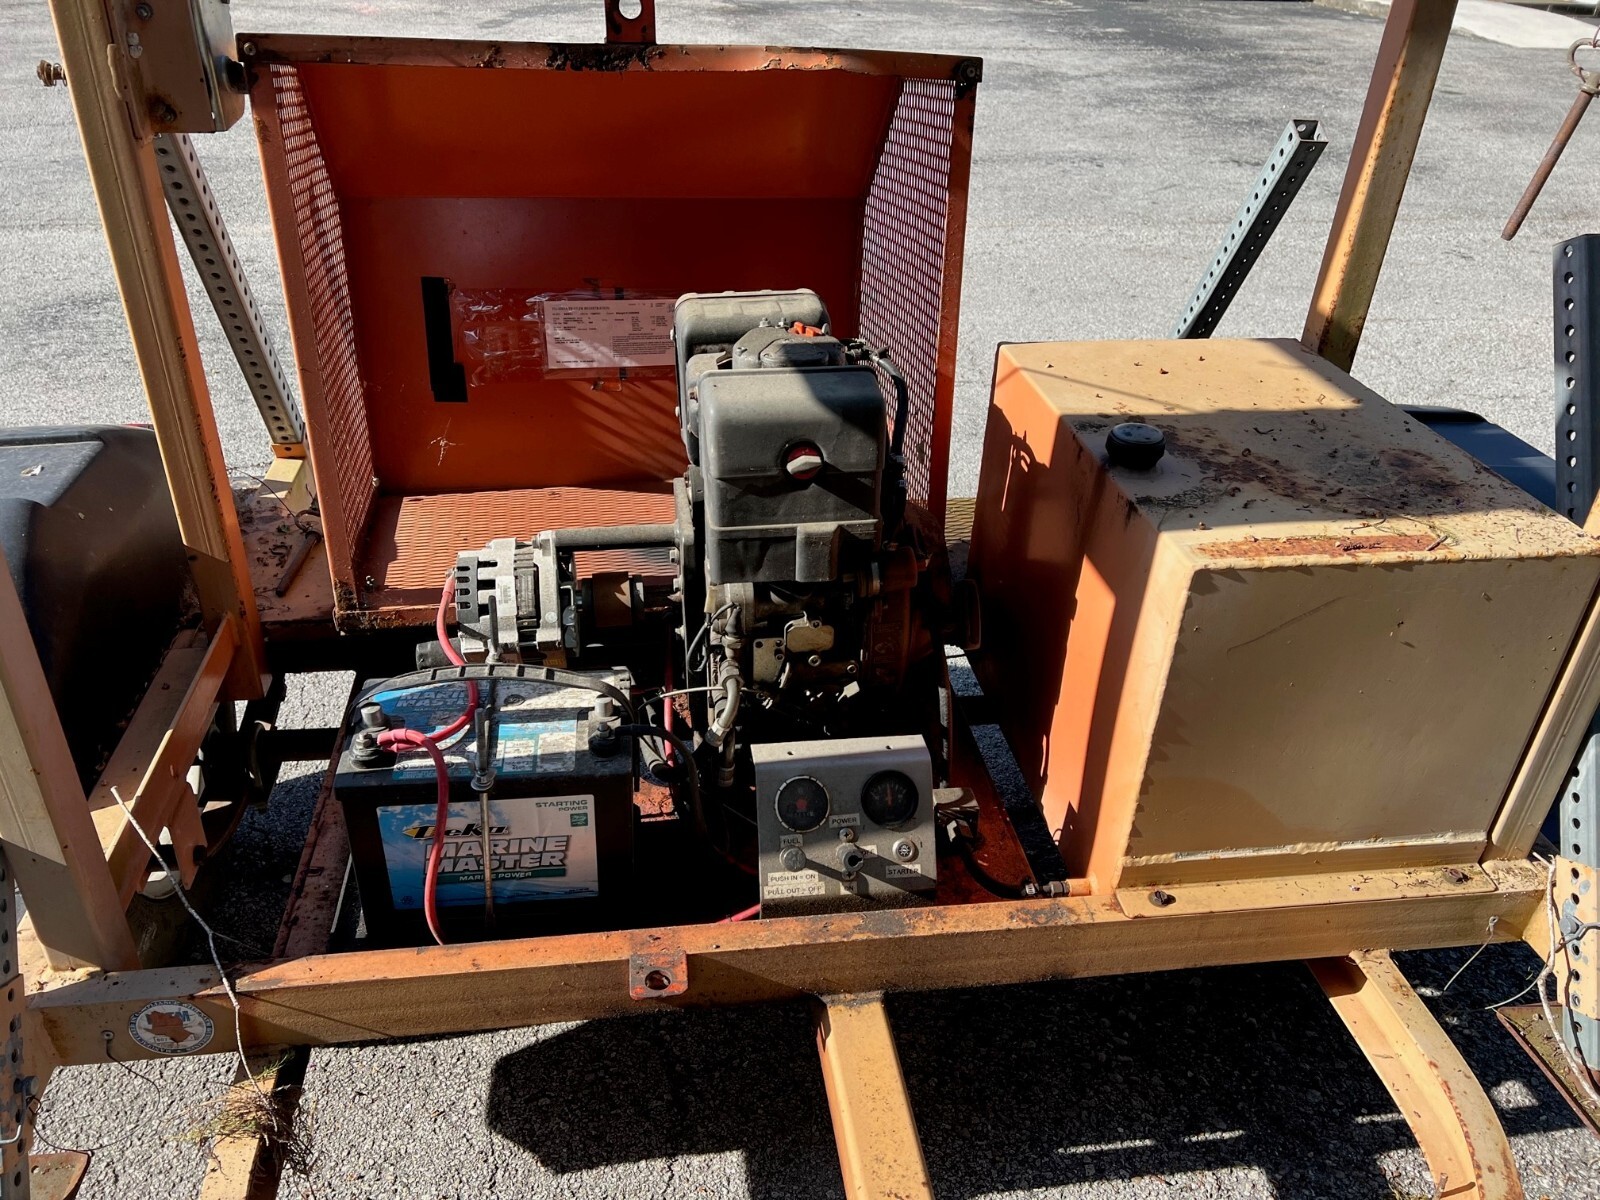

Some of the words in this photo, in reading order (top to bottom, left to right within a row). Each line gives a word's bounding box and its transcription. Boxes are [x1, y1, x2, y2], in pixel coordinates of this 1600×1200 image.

[535, 799, 588, 808] STARTING
[831, 817, 857, 825] POWER
[425, 835, 568, 858] MARINE
[424, 852, 565, 874] MASTER
[459, 873, 496, 881] MARIE
[498, 871, 532, 879] POWER
[888, 868, 918, 876] STARTER
[770, 875, 789, 883] PUSH
[805, 873, 816, 881] ON
[767, 888, 784, 896] PULL
